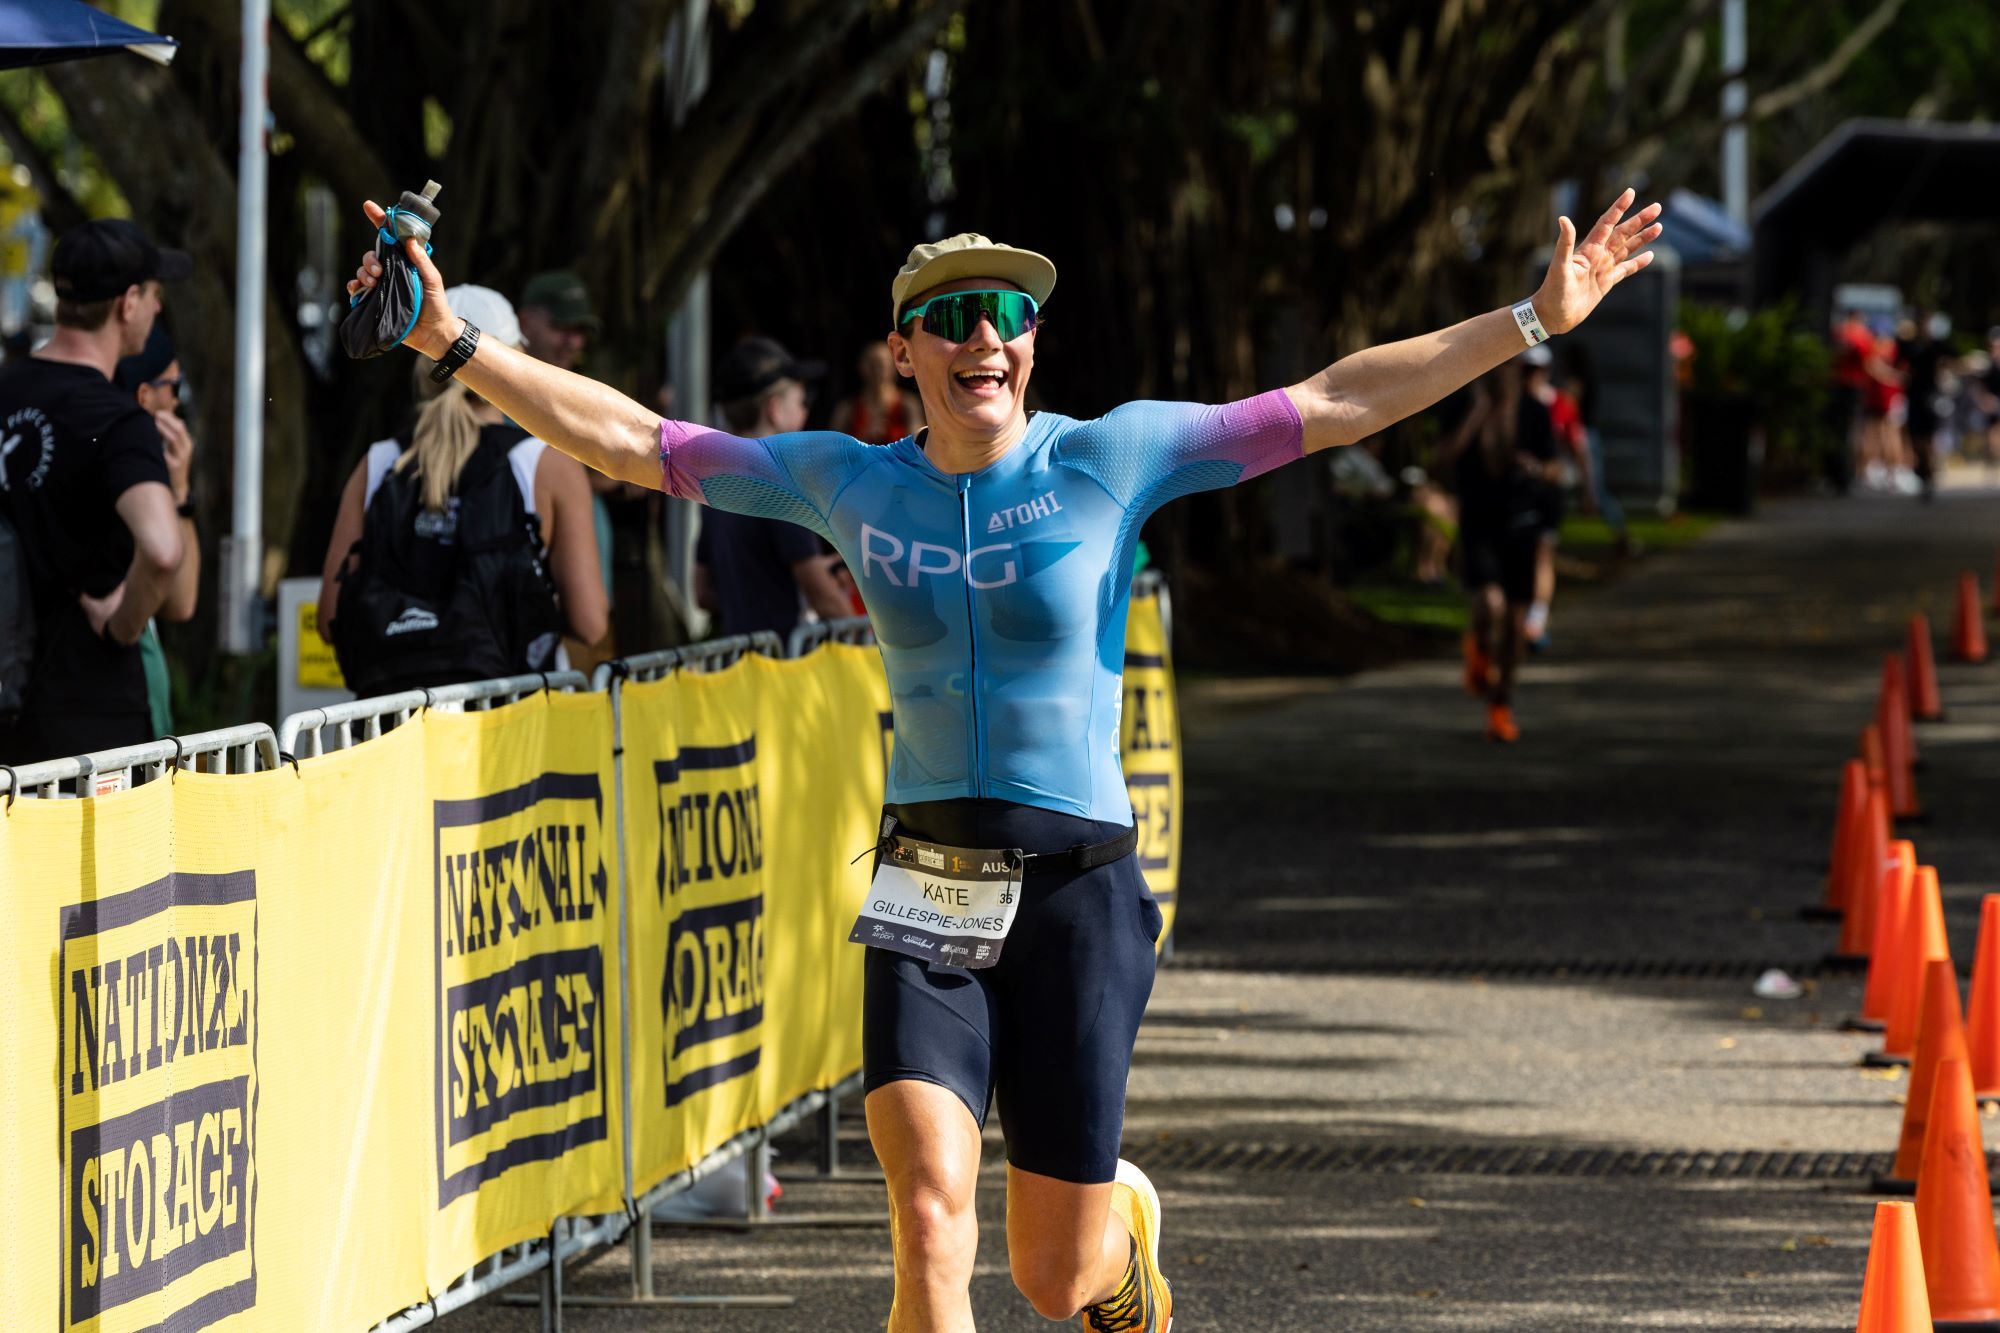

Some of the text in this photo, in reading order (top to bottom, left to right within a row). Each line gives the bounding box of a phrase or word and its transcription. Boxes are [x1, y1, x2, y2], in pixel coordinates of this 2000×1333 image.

[987, 490, 1063, 534] ATOHI
[860, 522, 1017, 590] RPG
[981, 861, 1010, 873] AUS
[873, 899, 1003, 932] GILLESPIE-JONES
[923, 881, 969, 906] KATE
[999, 893, 1013, 905] 36
[71, 933, 247, 1096] NATIONAL
[452, 973, 593, 1119] STORAGE
[81, 1107, 242, 1288] STORAGE
